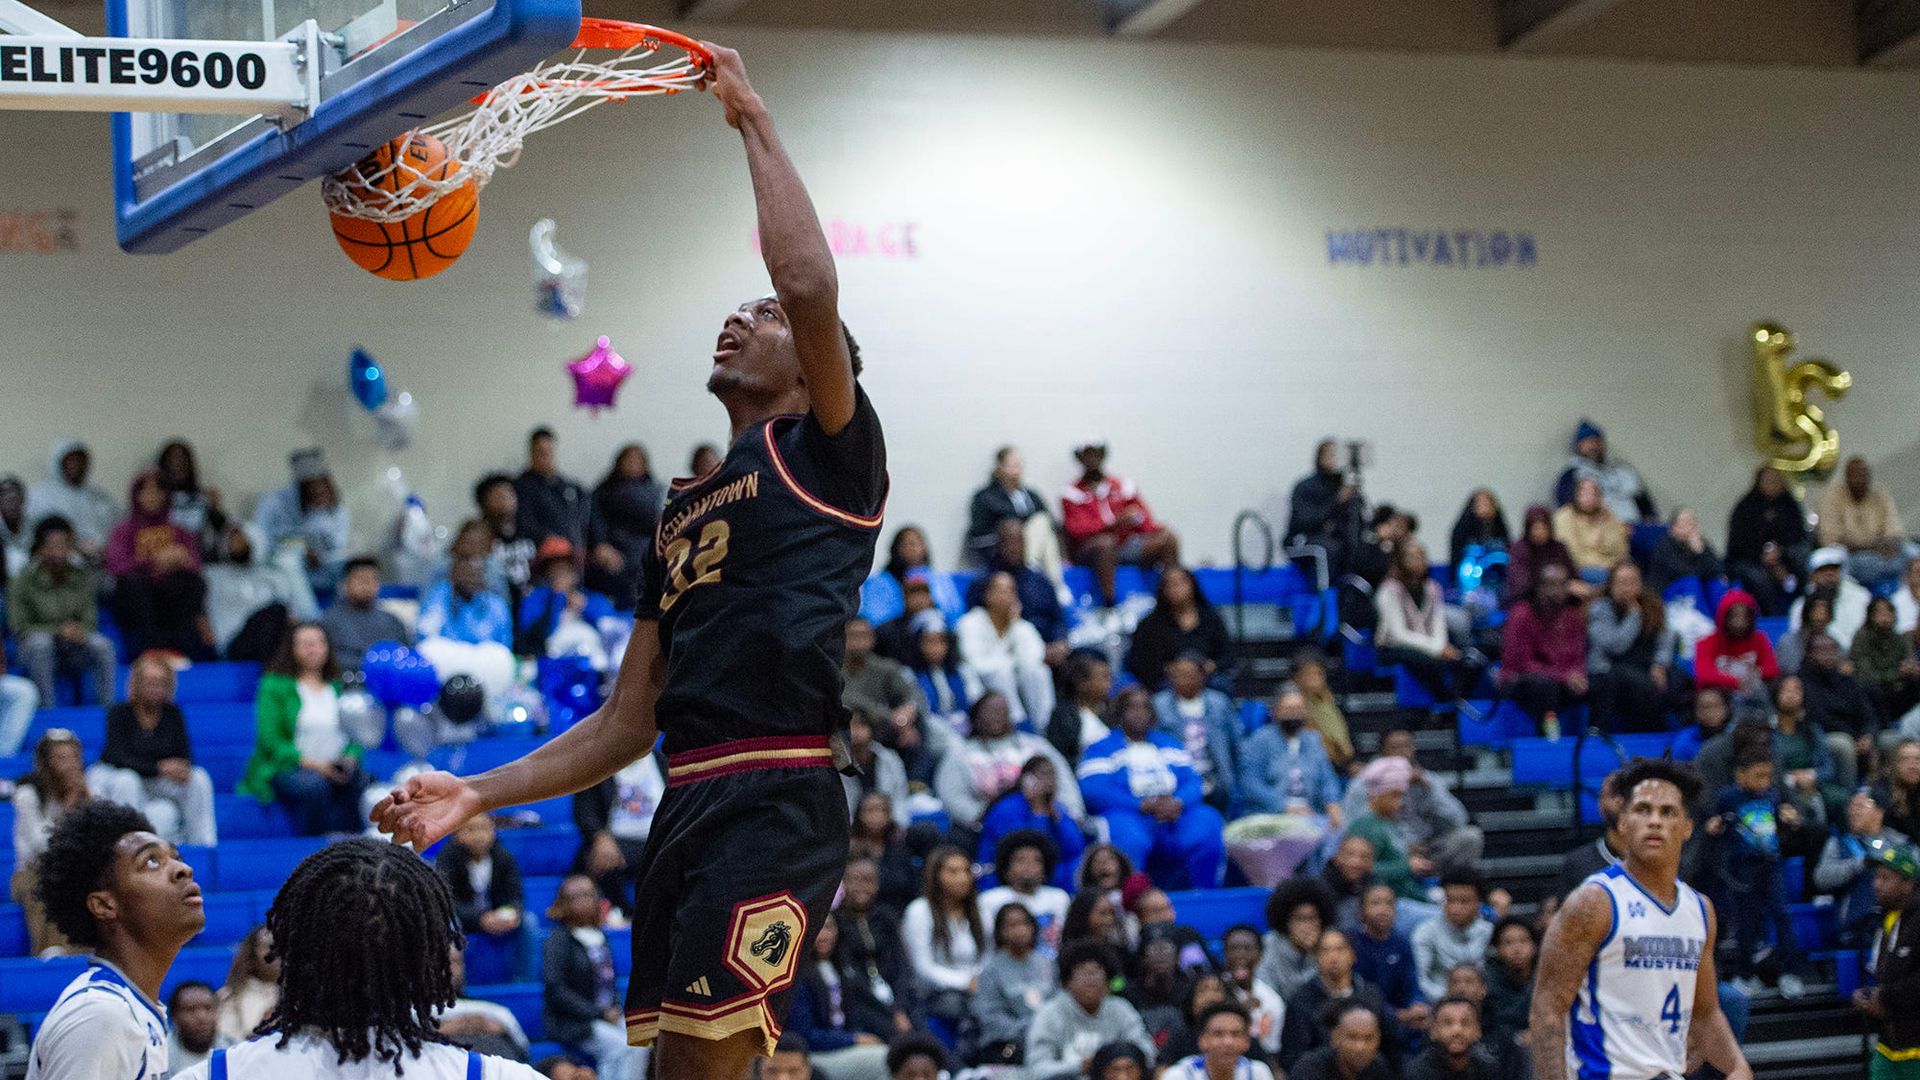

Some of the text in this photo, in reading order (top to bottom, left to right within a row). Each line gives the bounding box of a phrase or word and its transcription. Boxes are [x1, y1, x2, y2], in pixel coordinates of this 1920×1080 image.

[0, 45, 266, 90] ELITE9600
[1327, 227, 1537, 267] MOTIVATION
[1660, 983, 1682, 1034] 4
